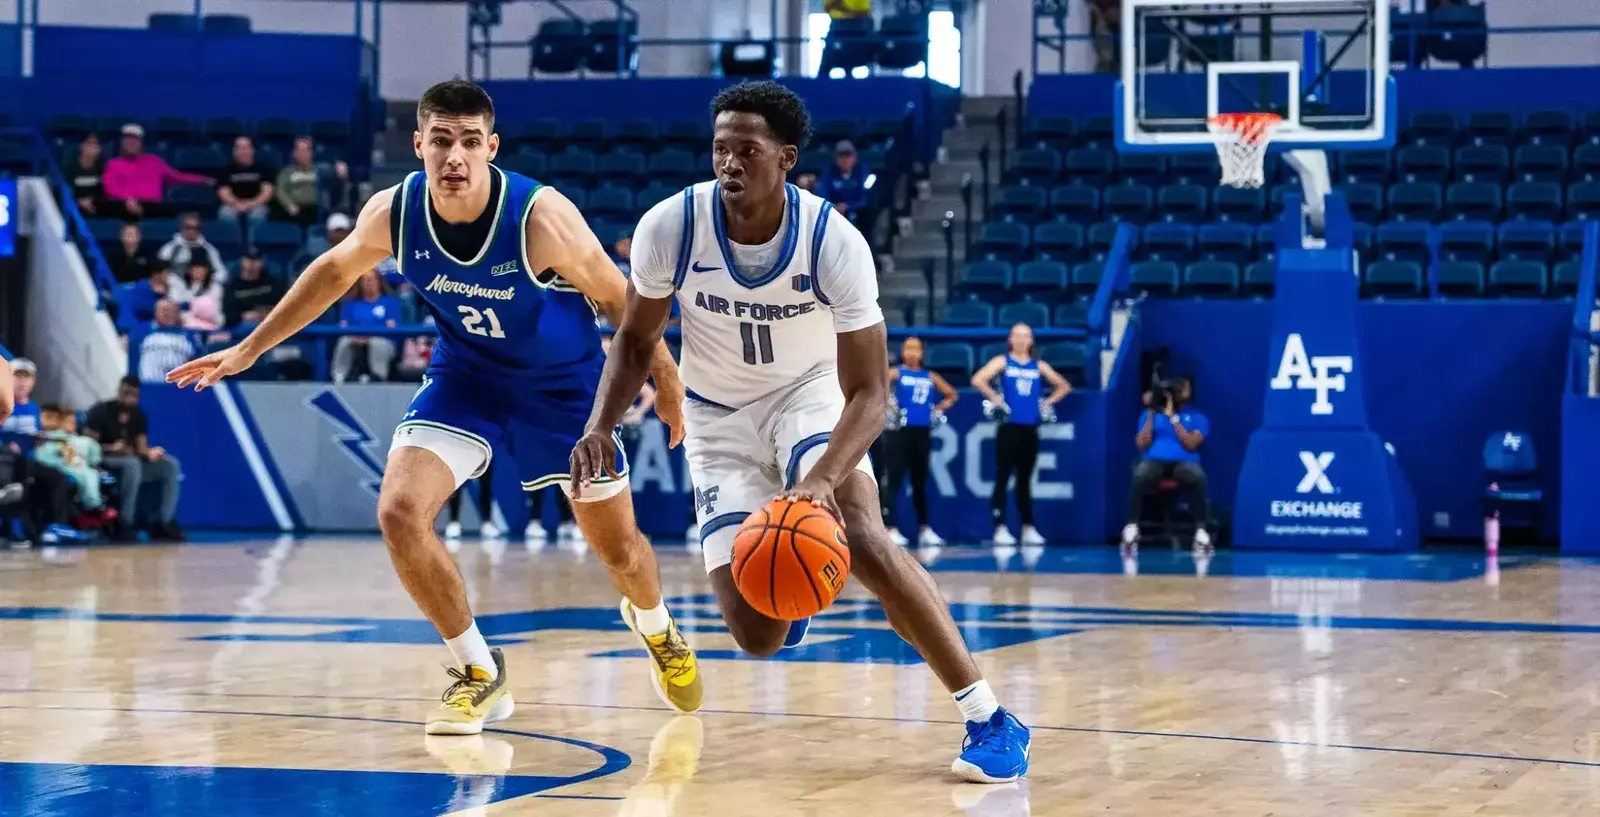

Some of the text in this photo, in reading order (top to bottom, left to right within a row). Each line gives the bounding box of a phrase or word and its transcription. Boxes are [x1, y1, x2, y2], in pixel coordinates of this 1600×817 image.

[491, 260, 518, 276] NEC
[424, 273, 515, 300] Mercyhurst
[695, 291, 815, 321] AIR FORCE
[457, 305, 506, 338] 21
[740, 322, 774, 365] 11
[1270, 333, 1353, 415] AF
[1296, 451, 1335, 494] X
[696, 485, 719, 515] AF
[1270, 500, 1363, 519] EXCHANGE
